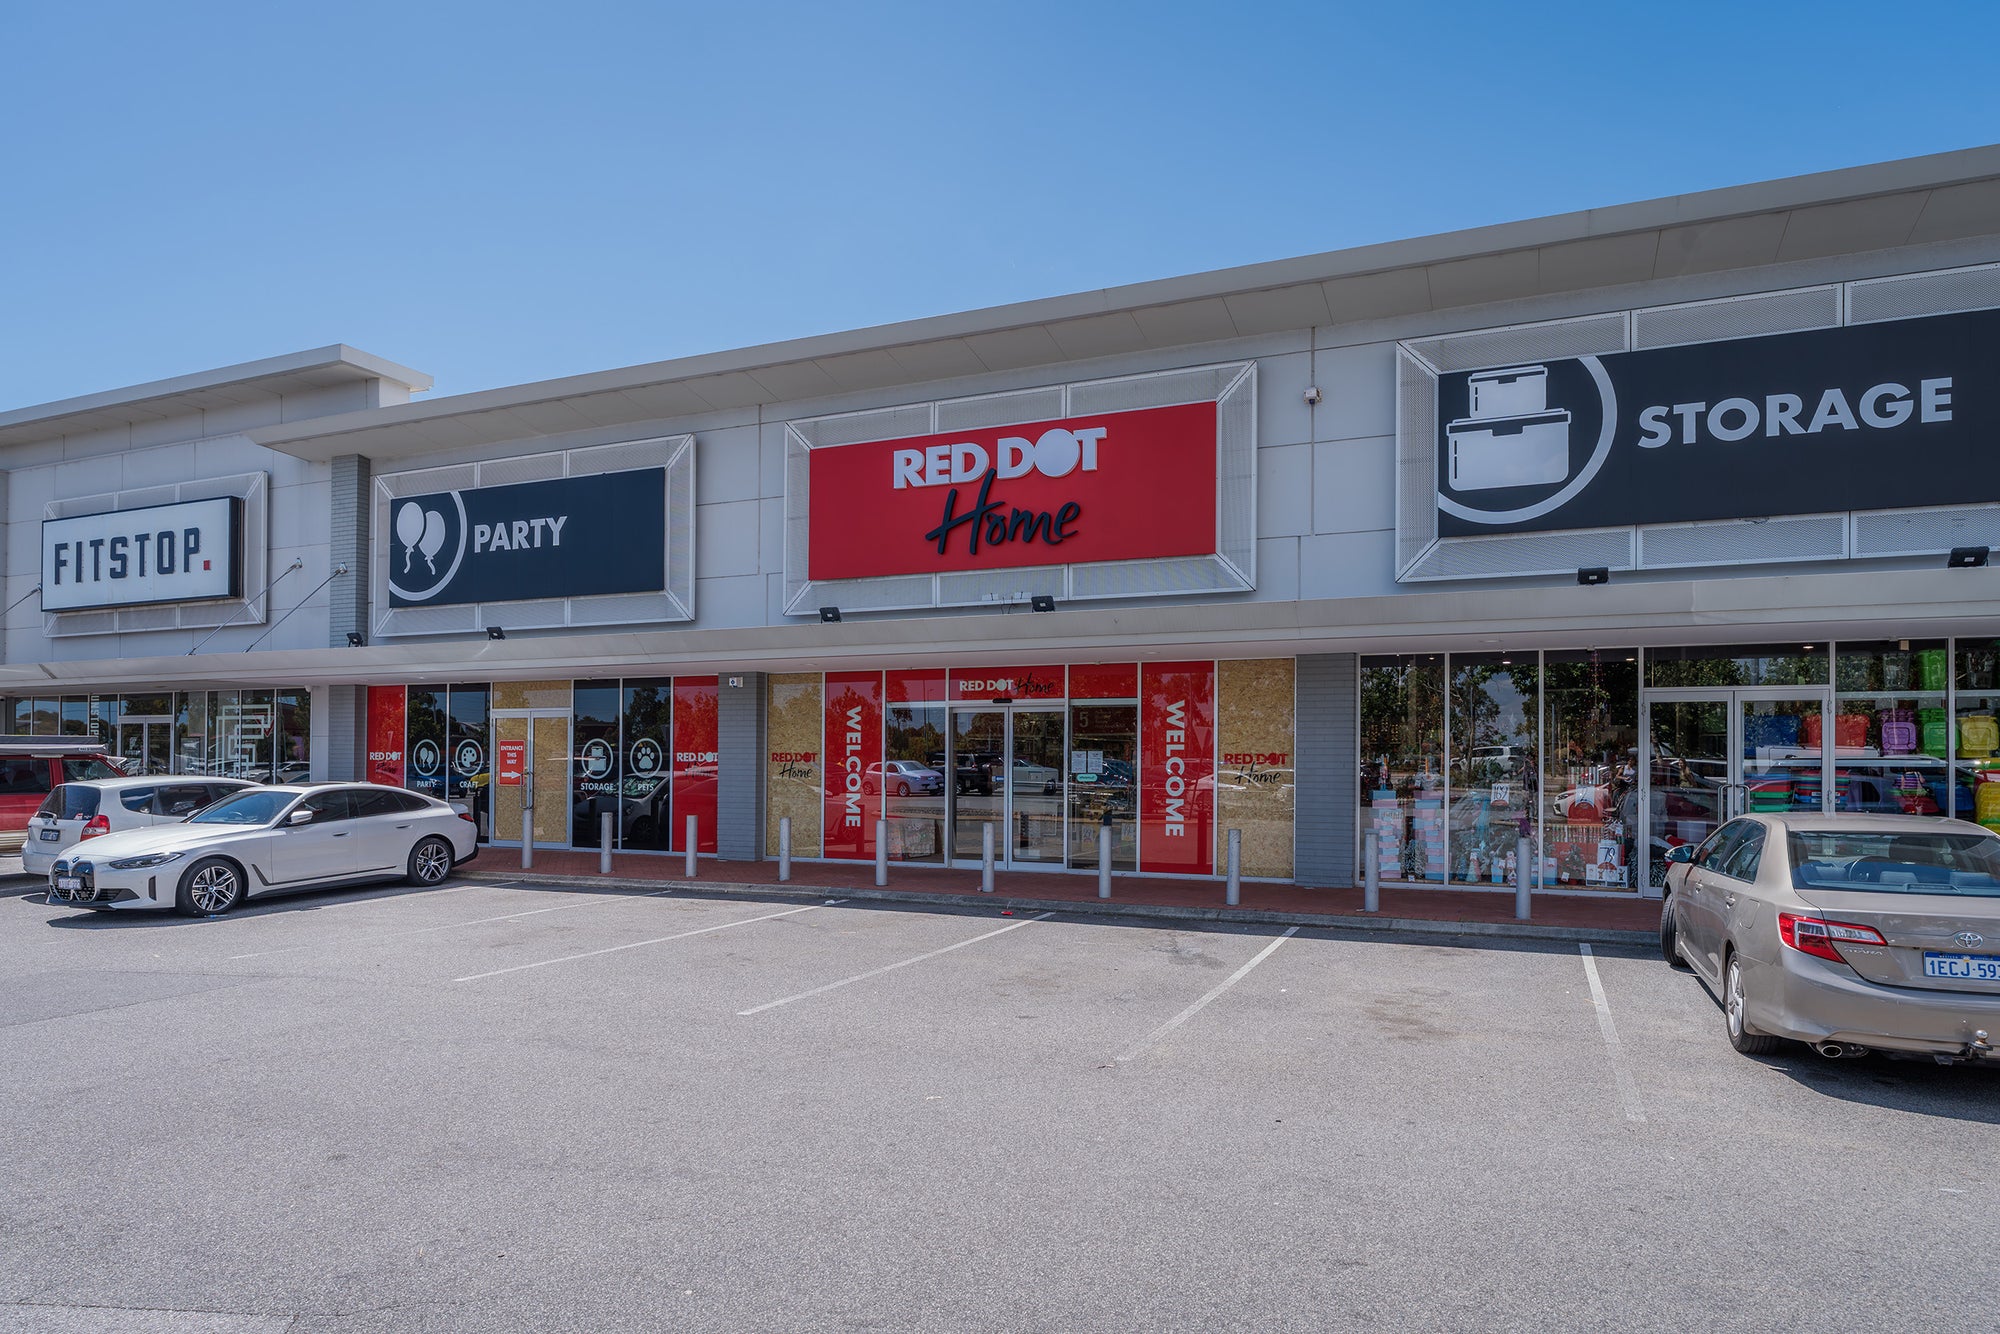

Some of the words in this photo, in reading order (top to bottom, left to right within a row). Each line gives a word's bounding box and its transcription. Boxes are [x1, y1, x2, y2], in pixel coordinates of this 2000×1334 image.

[1638, 376, 1953, 449] STORAGE
[893, 442, 990, 489] RED
[997, 426, 1107, 480] DOT
[925, 467, 1081, 555] Home
[474, 515, 568, 553] PARTY
[959, 680, 985, 692] RED
[986, 678, 1014, 692] DOT
[1013, 672, 1056, 695] Home
[369, 751, 385, 761] RED
[386, 751, 402, 761] DOT
[676, 752, 696, 762] RED
[697, 751, 718, 763] DOT
[771, 752, 793, 763] RED
[795, 751, 818, 763] DOT
[1223, 753, 1253, 765] RED
[1256, 752, 1289, 765] DOT
[779, 760, 813, 779] Home
[845, 705, 862, 828] WELCOME
[1165, 700, 1185, 837] WELCOME
[1234, 761, 1281, 784] Home
[416, 780, 436, 788] PARTY
[459, 780, 478, 789] CRAFT
[580, 782, 615, 791] STORAGE
[637, 783, 654, 791] PETS
